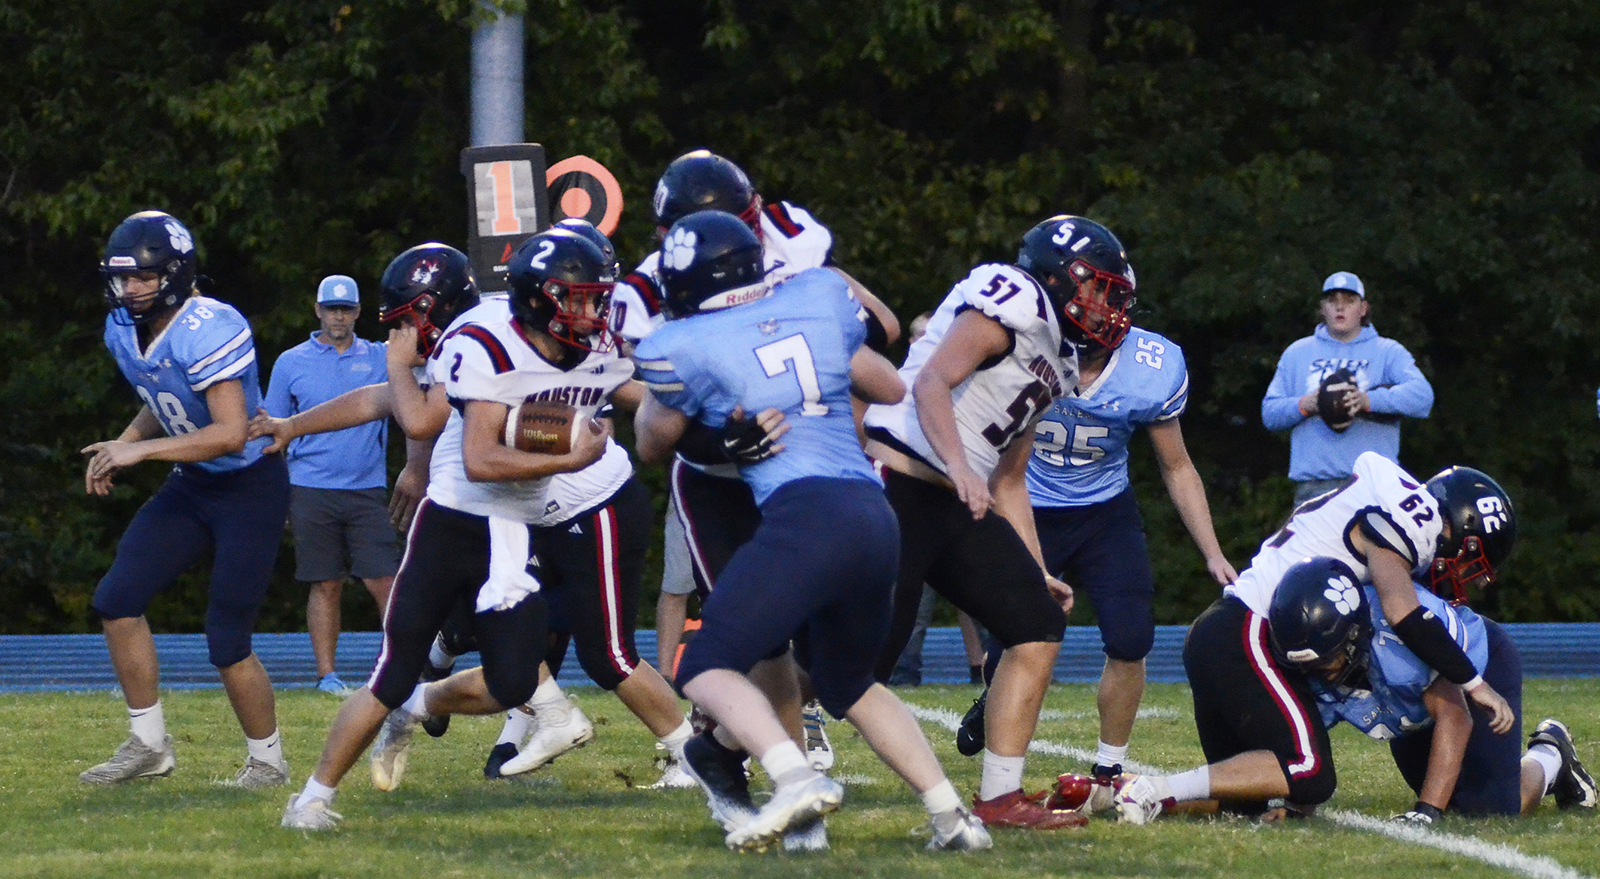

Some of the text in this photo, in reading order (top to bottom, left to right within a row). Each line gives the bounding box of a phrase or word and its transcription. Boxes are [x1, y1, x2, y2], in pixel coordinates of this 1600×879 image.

[487, 160, 521, 236] 1
[530, 240, 556, 270] 2
[979, 273, 1022, 306] 57
[181, 305, 215, 331] 38
[450, 352, 463, 383] 2
[1135, 337, 1165, 370] 25
[752, 332, 829, 416] 7
[1054, 404, 1095, 420] SALE
[1033, 420, 1110, 467] 25
[1399, 493, 1434, 529] 62
[1476, 496, 1508, 534] 62
